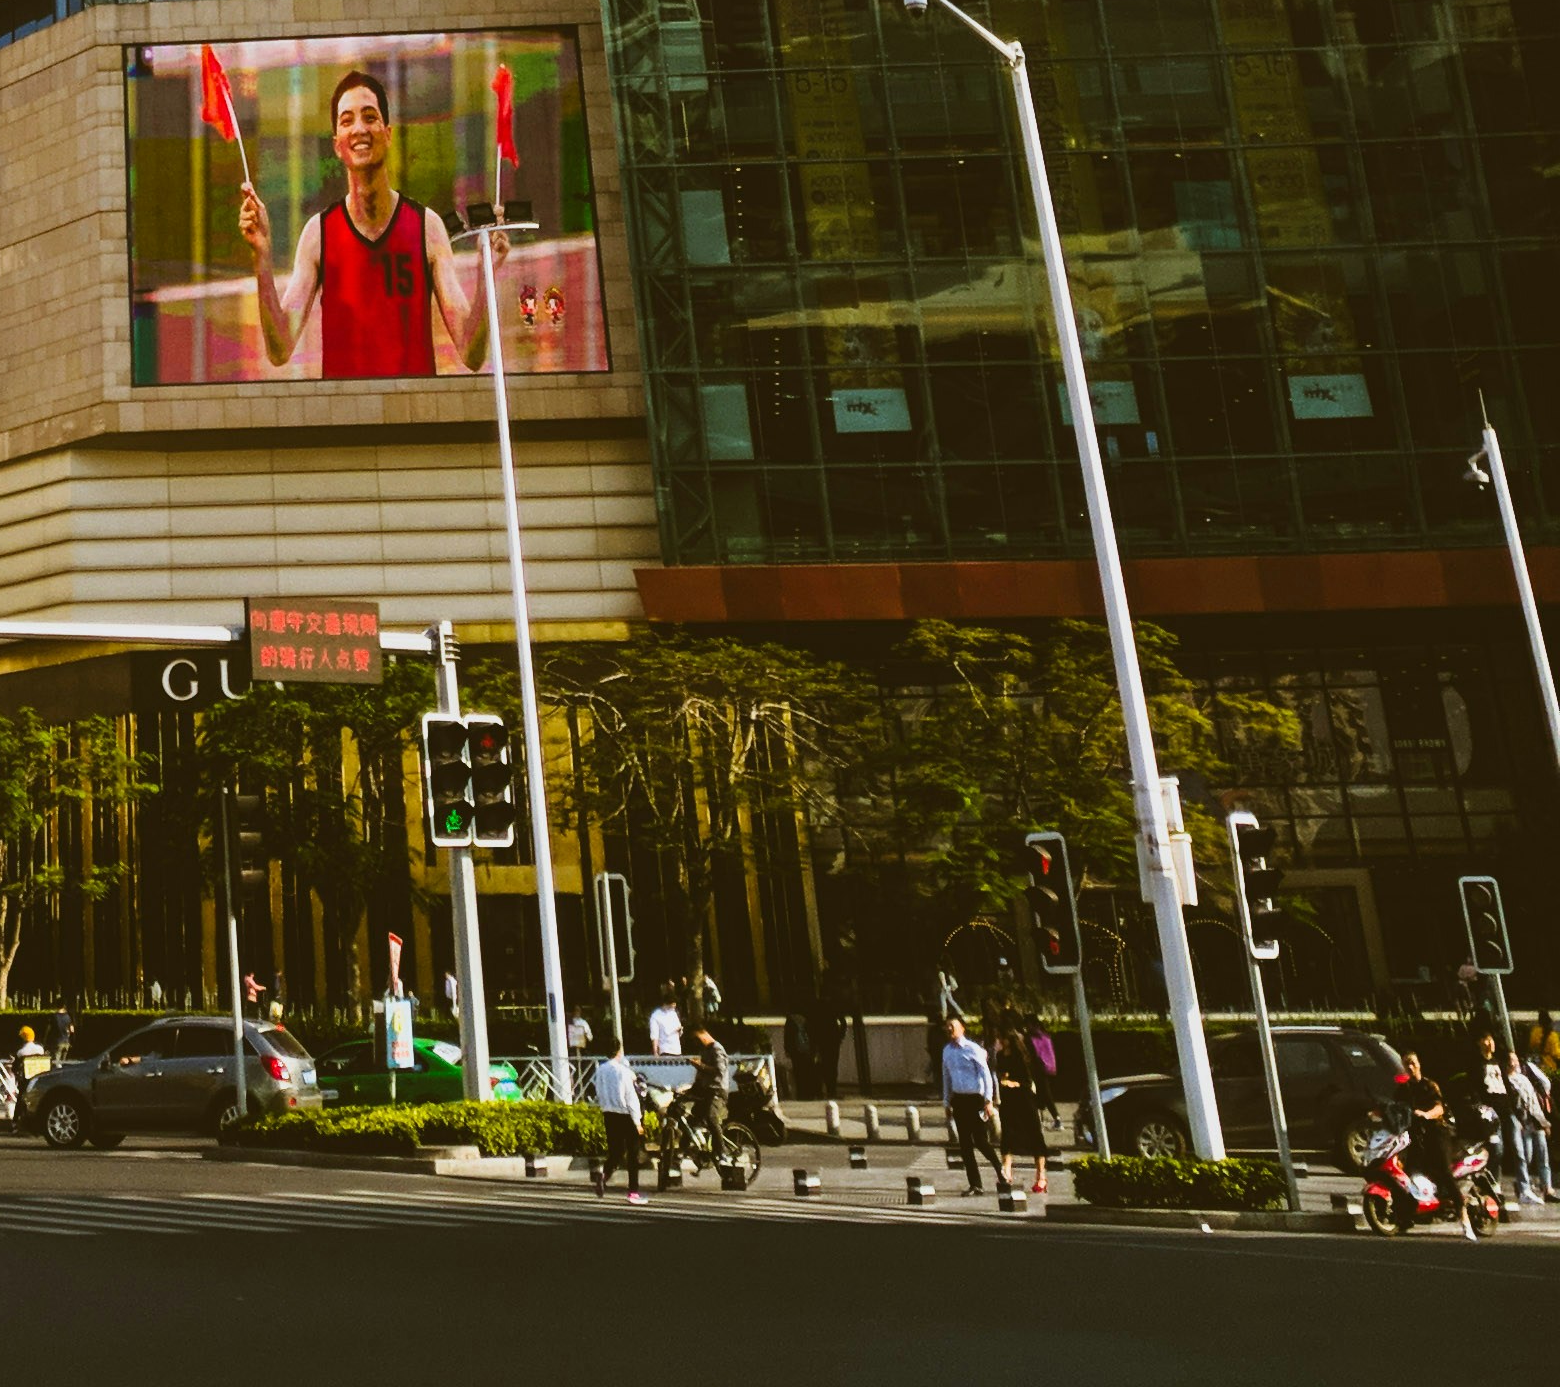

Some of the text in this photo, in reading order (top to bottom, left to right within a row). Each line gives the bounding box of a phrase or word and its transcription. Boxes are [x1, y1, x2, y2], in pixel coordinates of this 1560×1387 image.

[381, 252, 414, 298] 15
[249, 609, 378, 636] 向遵守交通规则
[259, 645, 372, 671] 的骑行人点赞
